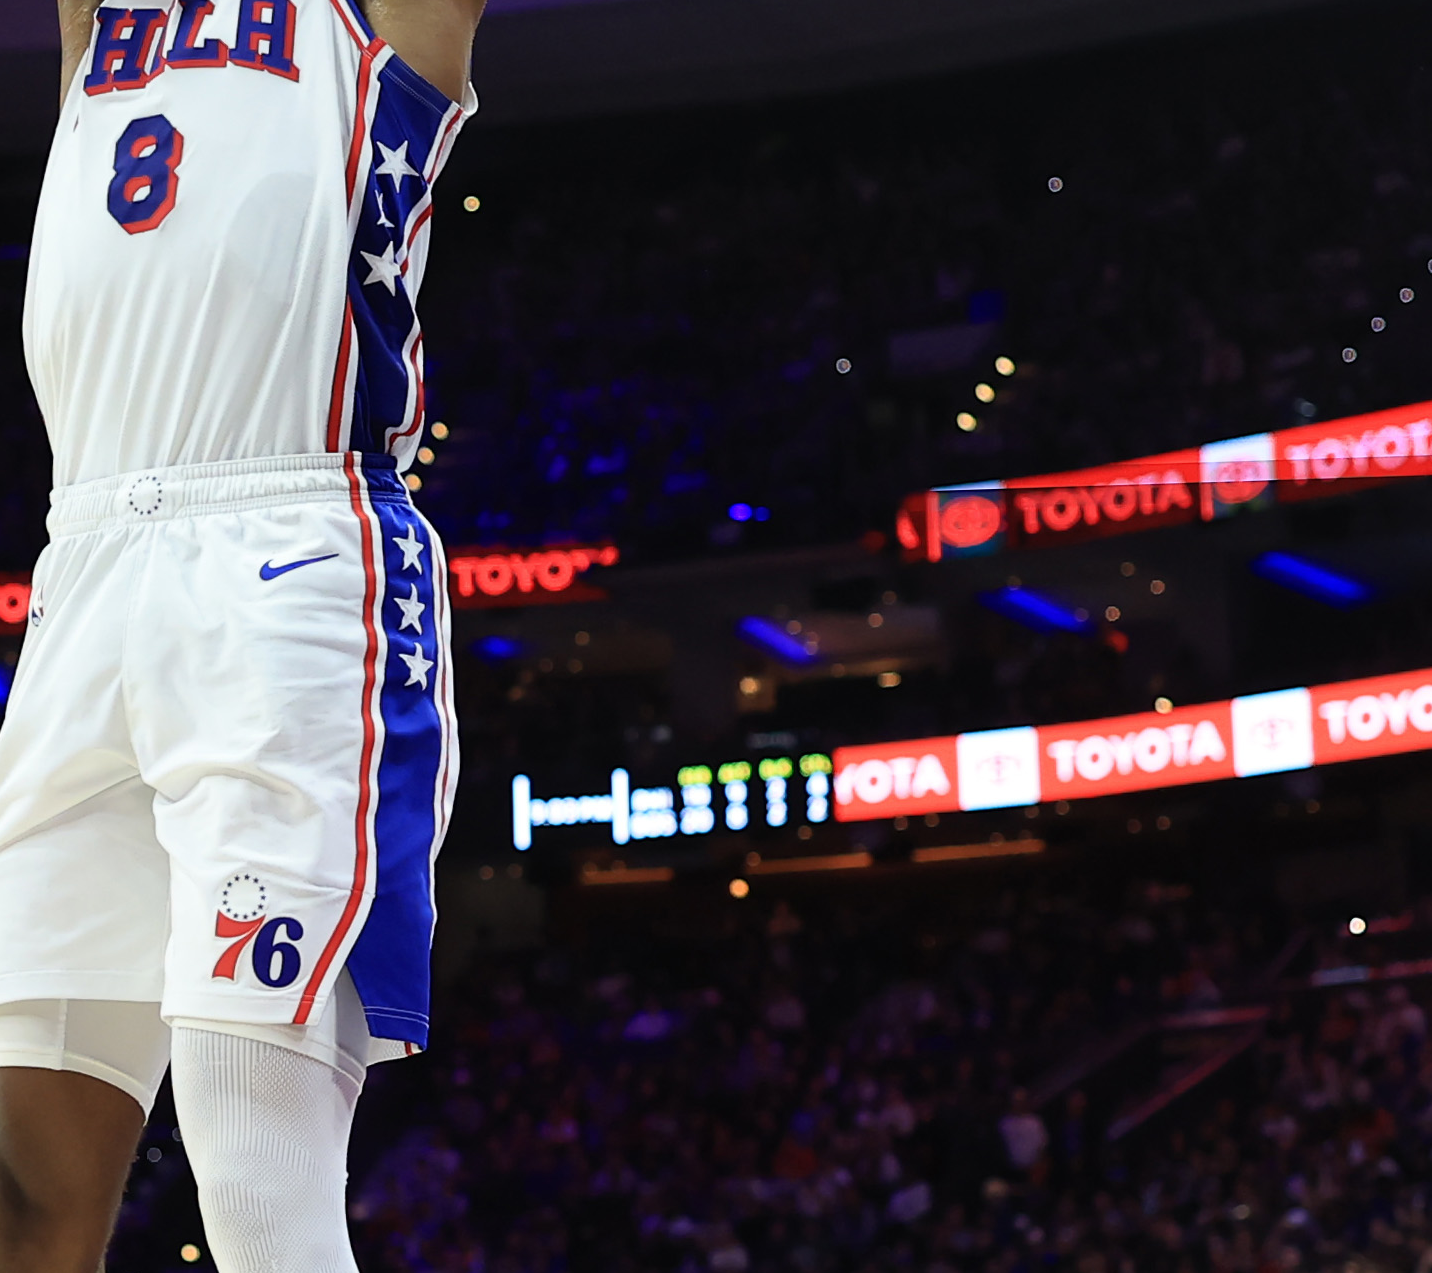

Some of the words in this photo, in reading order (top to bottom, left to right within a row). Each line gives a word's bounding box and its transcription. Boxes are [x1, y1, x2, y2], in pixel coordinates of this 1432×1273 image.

[106, 113, 185, 236] 8
[1017, 466, 1192, 535] TOYOTA
[449, 546, 619, 597] TOYO
[1047, 719, 1227, 784] TOYOTA
[210, 909, 304, 989] 76
